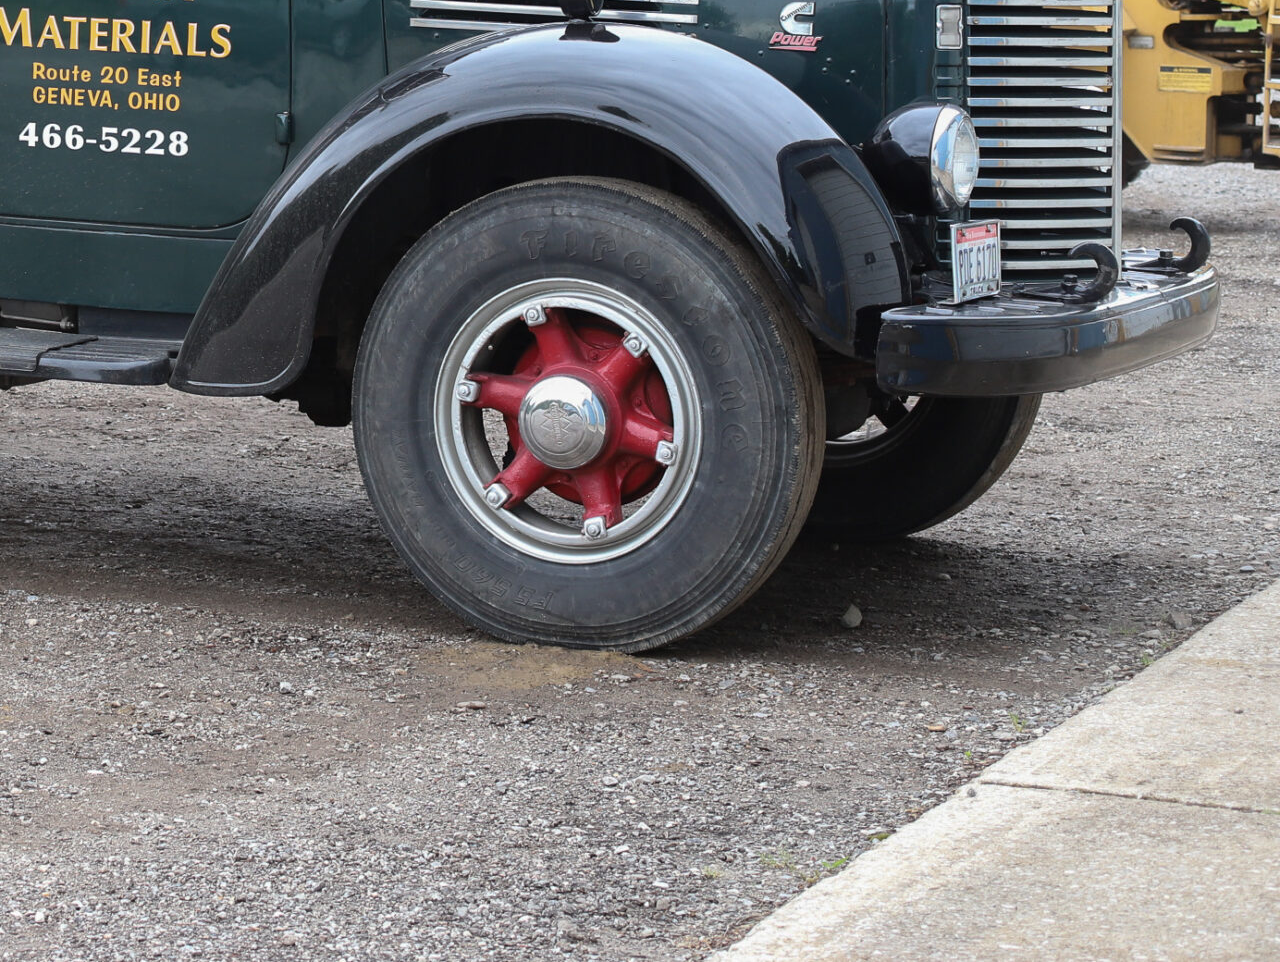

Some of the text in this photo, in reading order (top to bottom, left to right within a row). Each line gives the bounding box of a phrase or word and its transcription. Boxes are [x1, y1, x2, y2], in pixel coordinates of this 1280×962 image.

[769, 31, 824, 47] Power
[32, 62, 182, 88] Route 20 East
[32, 86, 181, 112] GENEVA, OHIO
[18, 122, 190, 157] 466-5228
